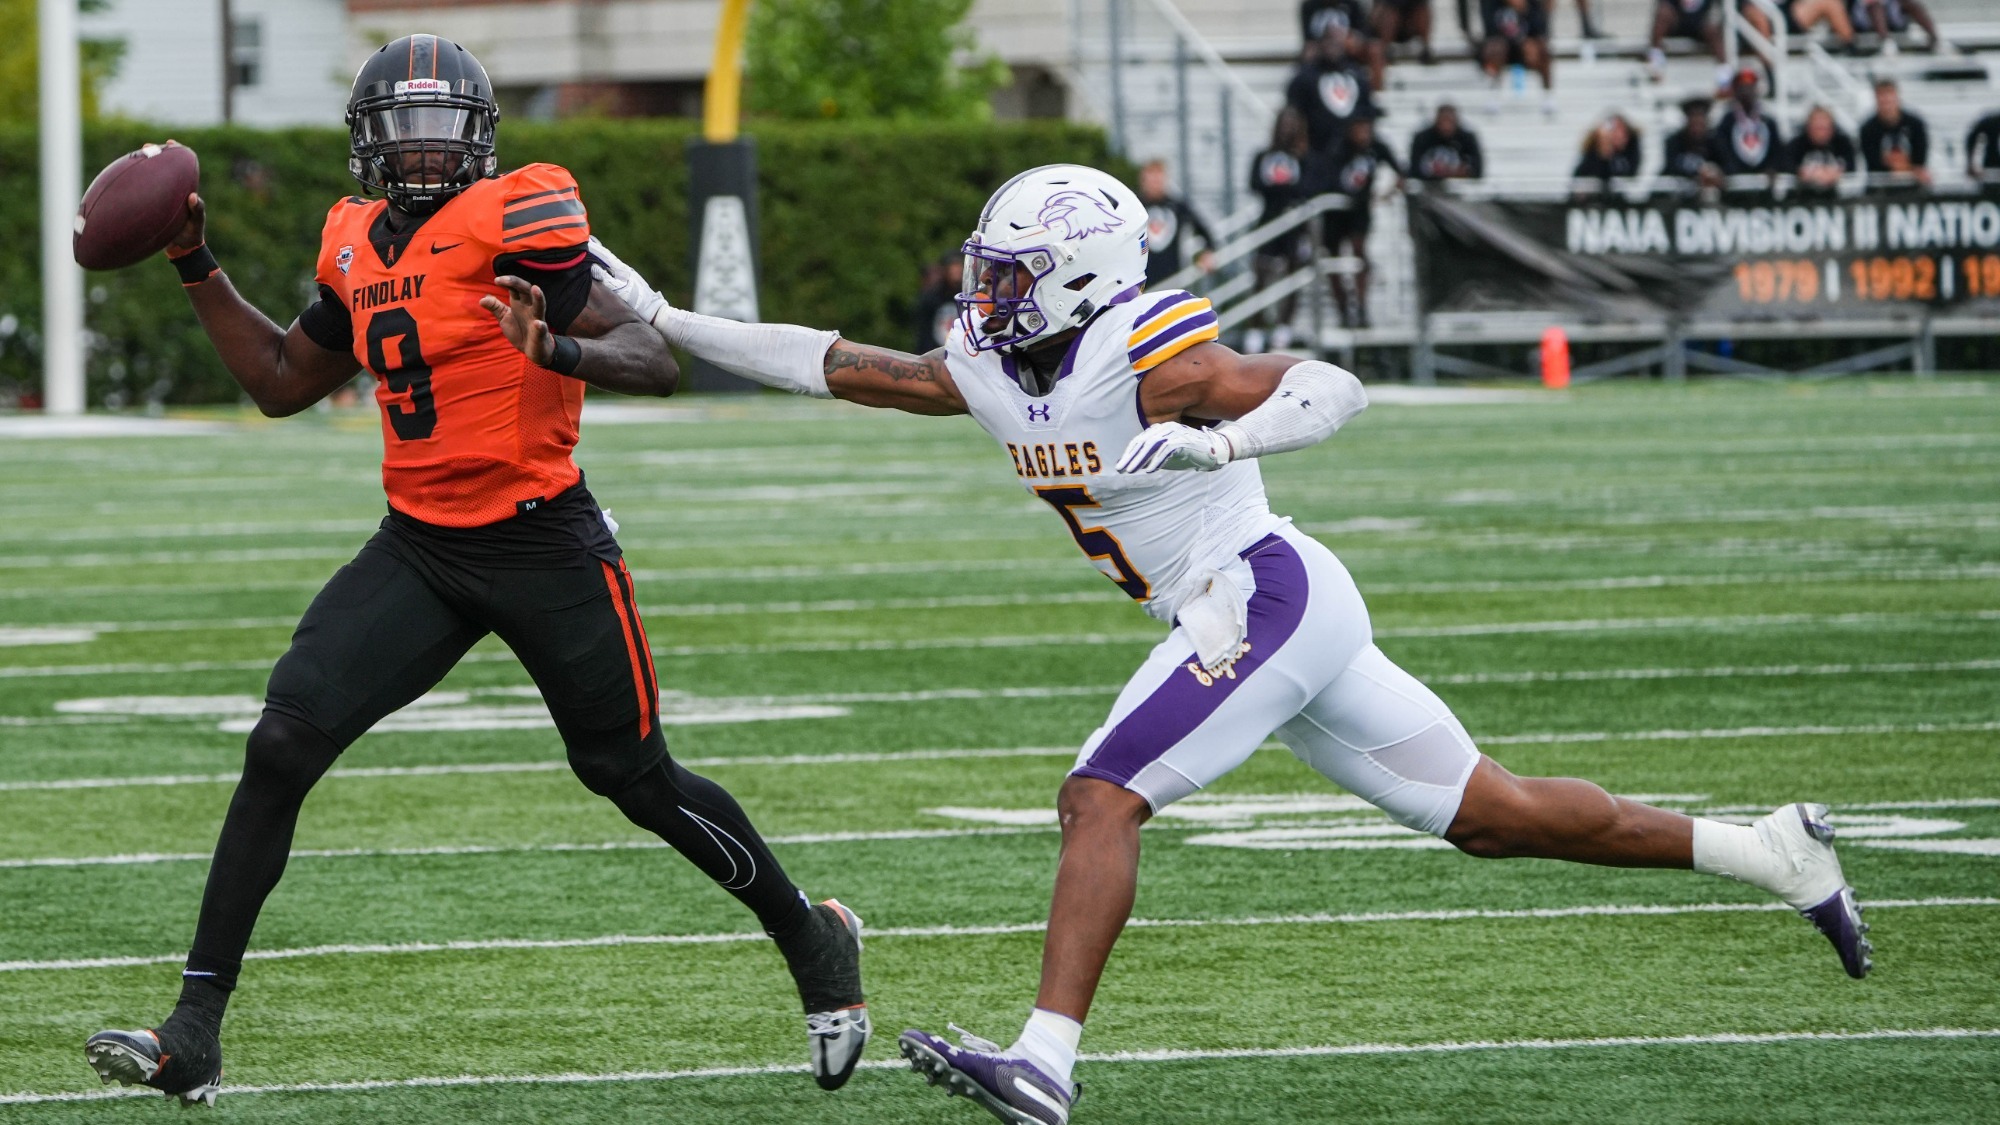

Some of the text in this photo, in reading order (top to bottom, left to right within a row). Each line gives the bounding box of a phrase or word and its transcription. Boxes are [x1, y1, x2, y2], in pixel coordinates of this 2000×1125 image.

[407, 81, 438, 90] Riddell
[1566, 201, 2000, 255] NAIA DIVISION II NATIO
[352, 274, 426, 313] FINDLAY
[1733, 258, 1819, 304] 1979
[1850, 255, 1936, 300] 1992
[366, 306, 438, 441] 9
[1006, 441, 1102, 479] EAGLES
[525, 501, 537, 511] M
[1032, 483, 1153, 603] 5
